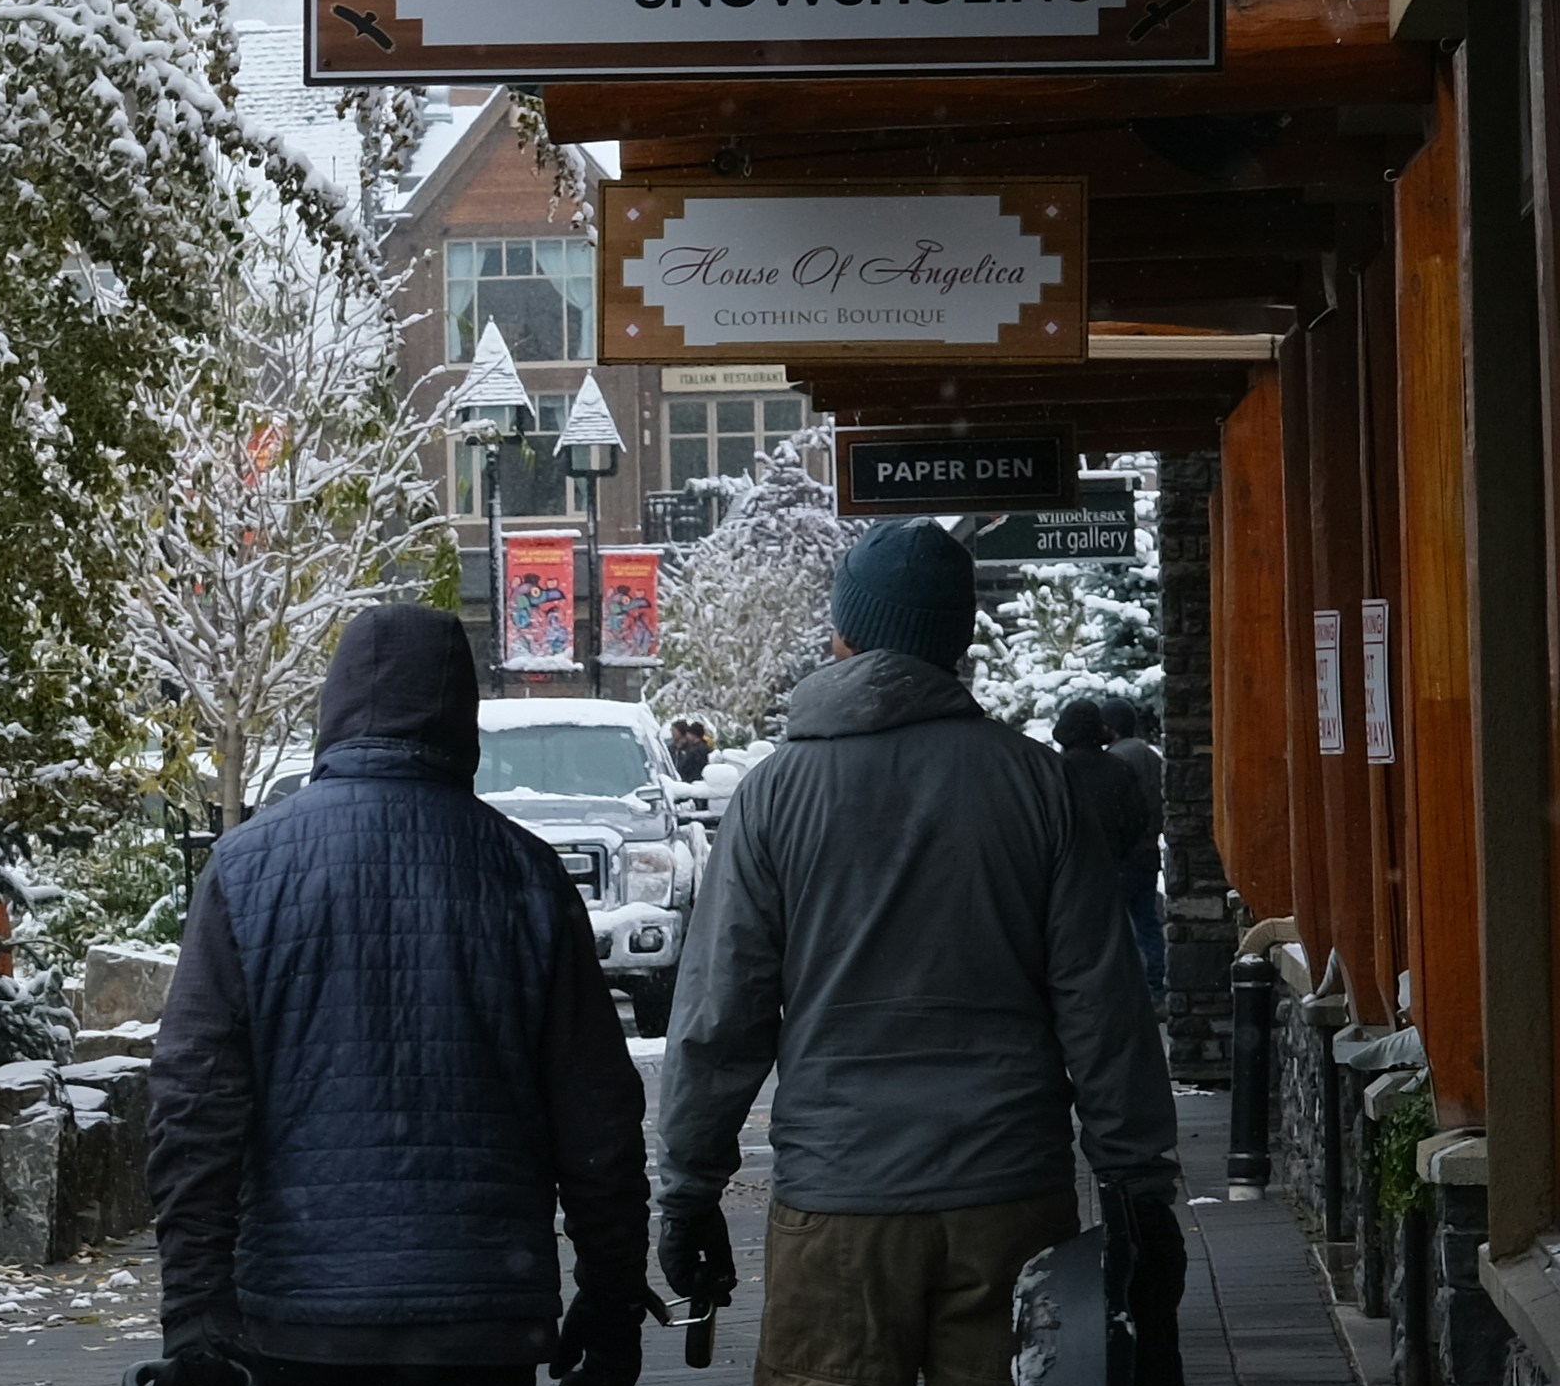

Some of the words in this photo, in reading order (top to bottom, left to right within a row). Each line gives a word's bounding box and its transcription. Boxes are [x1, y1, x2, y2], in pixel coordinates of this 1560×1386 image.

[658, 245, 780, 288] House
[790, 246, 853, 295] Of
[859, 238, 1026, 295] Angelica
[680, 373, 716, 385] ITALIAN
[723, 371, 784, 384] RESTAURANT
[877, 460, 965, 483] PAPER
[976, 457, 1034, 480] DEN
[1037, 529, 1062, 550] art
[1067, 526, 1128, 555] gallery
